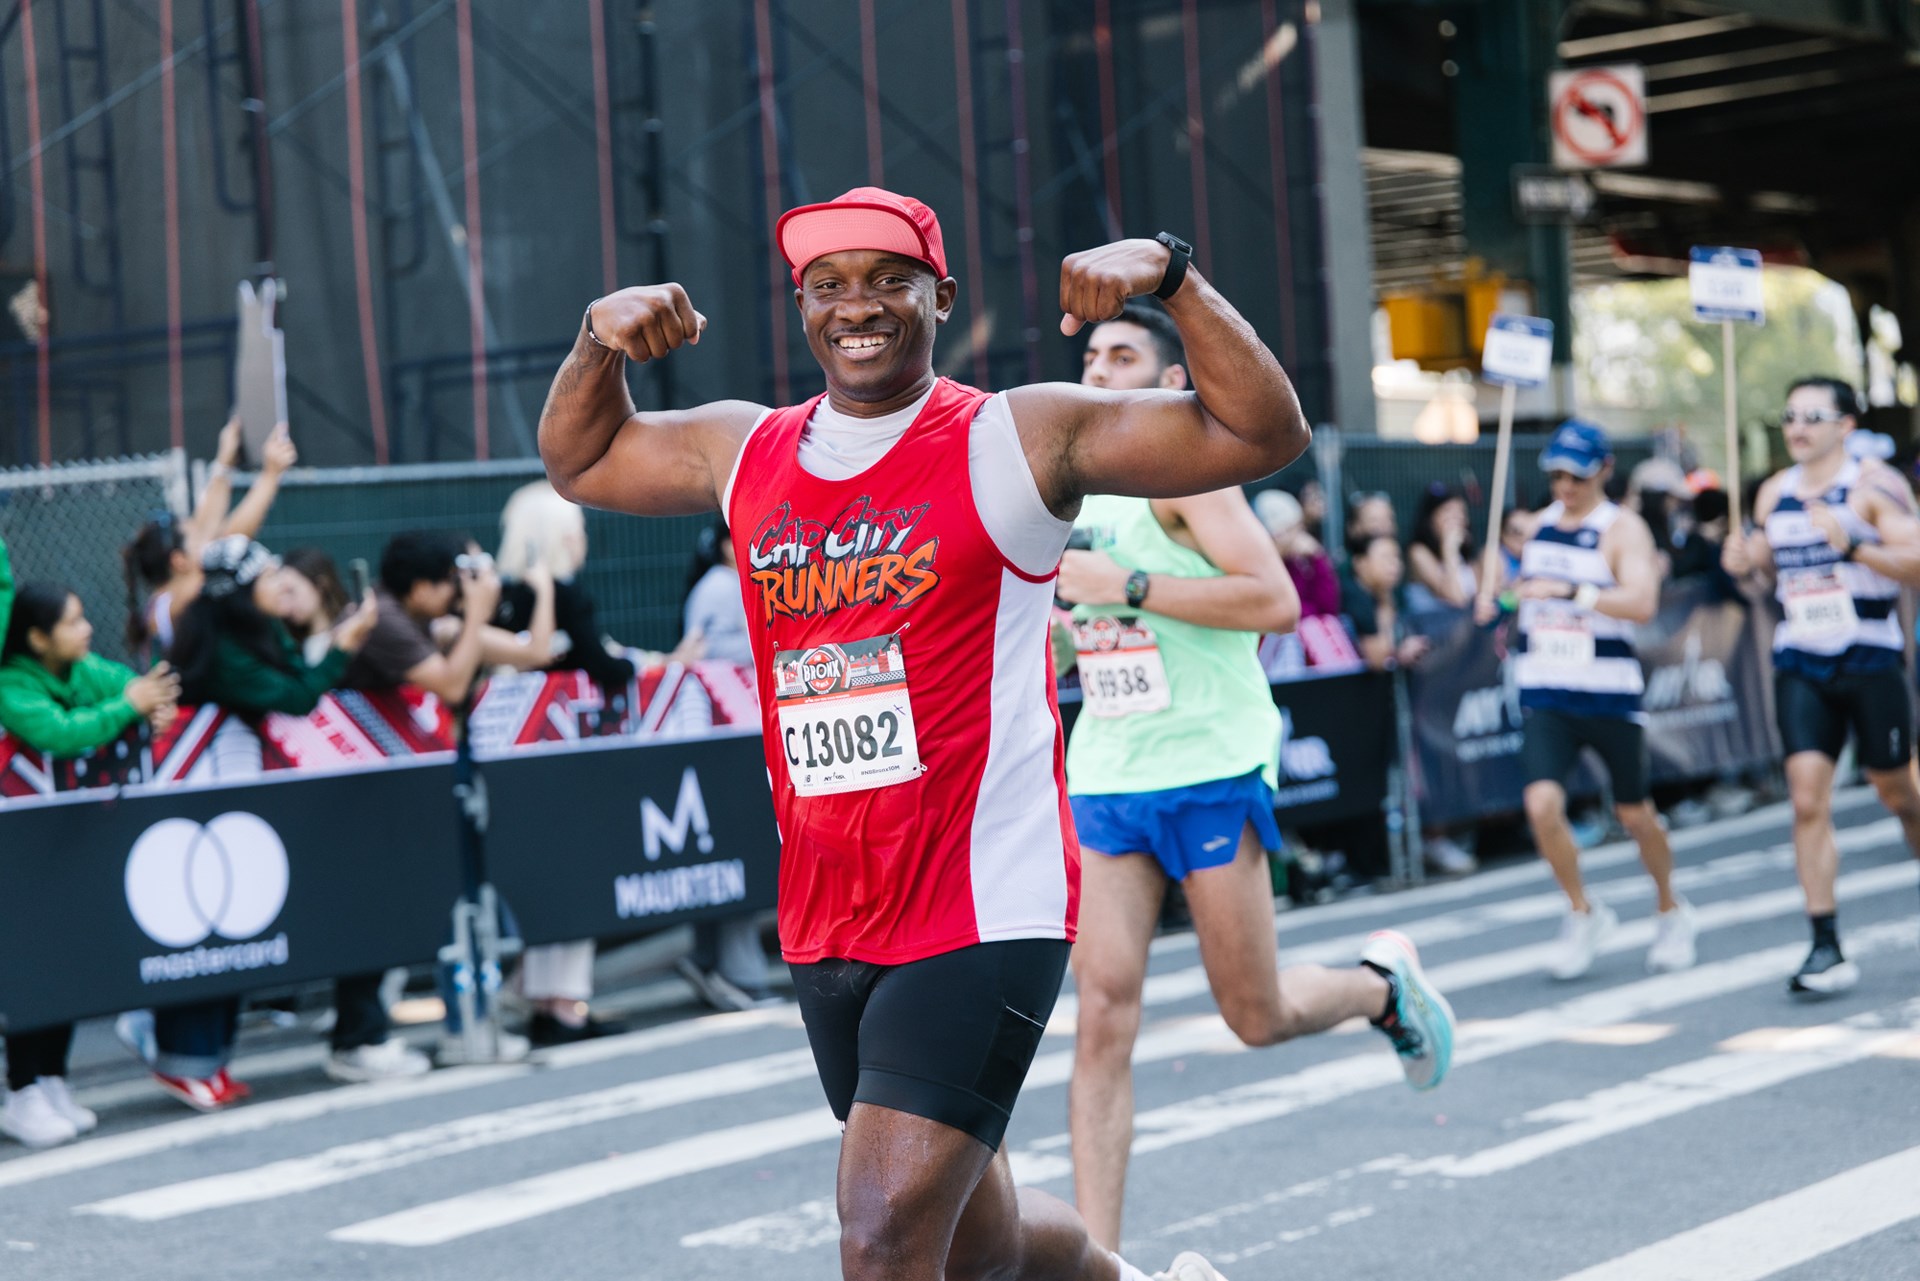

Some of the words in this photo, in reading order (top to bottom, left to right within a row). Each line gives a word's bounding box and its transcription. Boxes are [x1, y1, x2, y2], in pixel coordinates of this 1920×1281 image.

[750, 501, 827, 570] CAP
[825, 495, 931, 559] CITY
[750, 537, 942, 630] RUNNERS
[802, 659, 841, 682] BRONX
[802, 710, 903, 768] 13082
[614, 857, 746, 919] MAURTEN
[139, 930, 290, 985] mastercard
